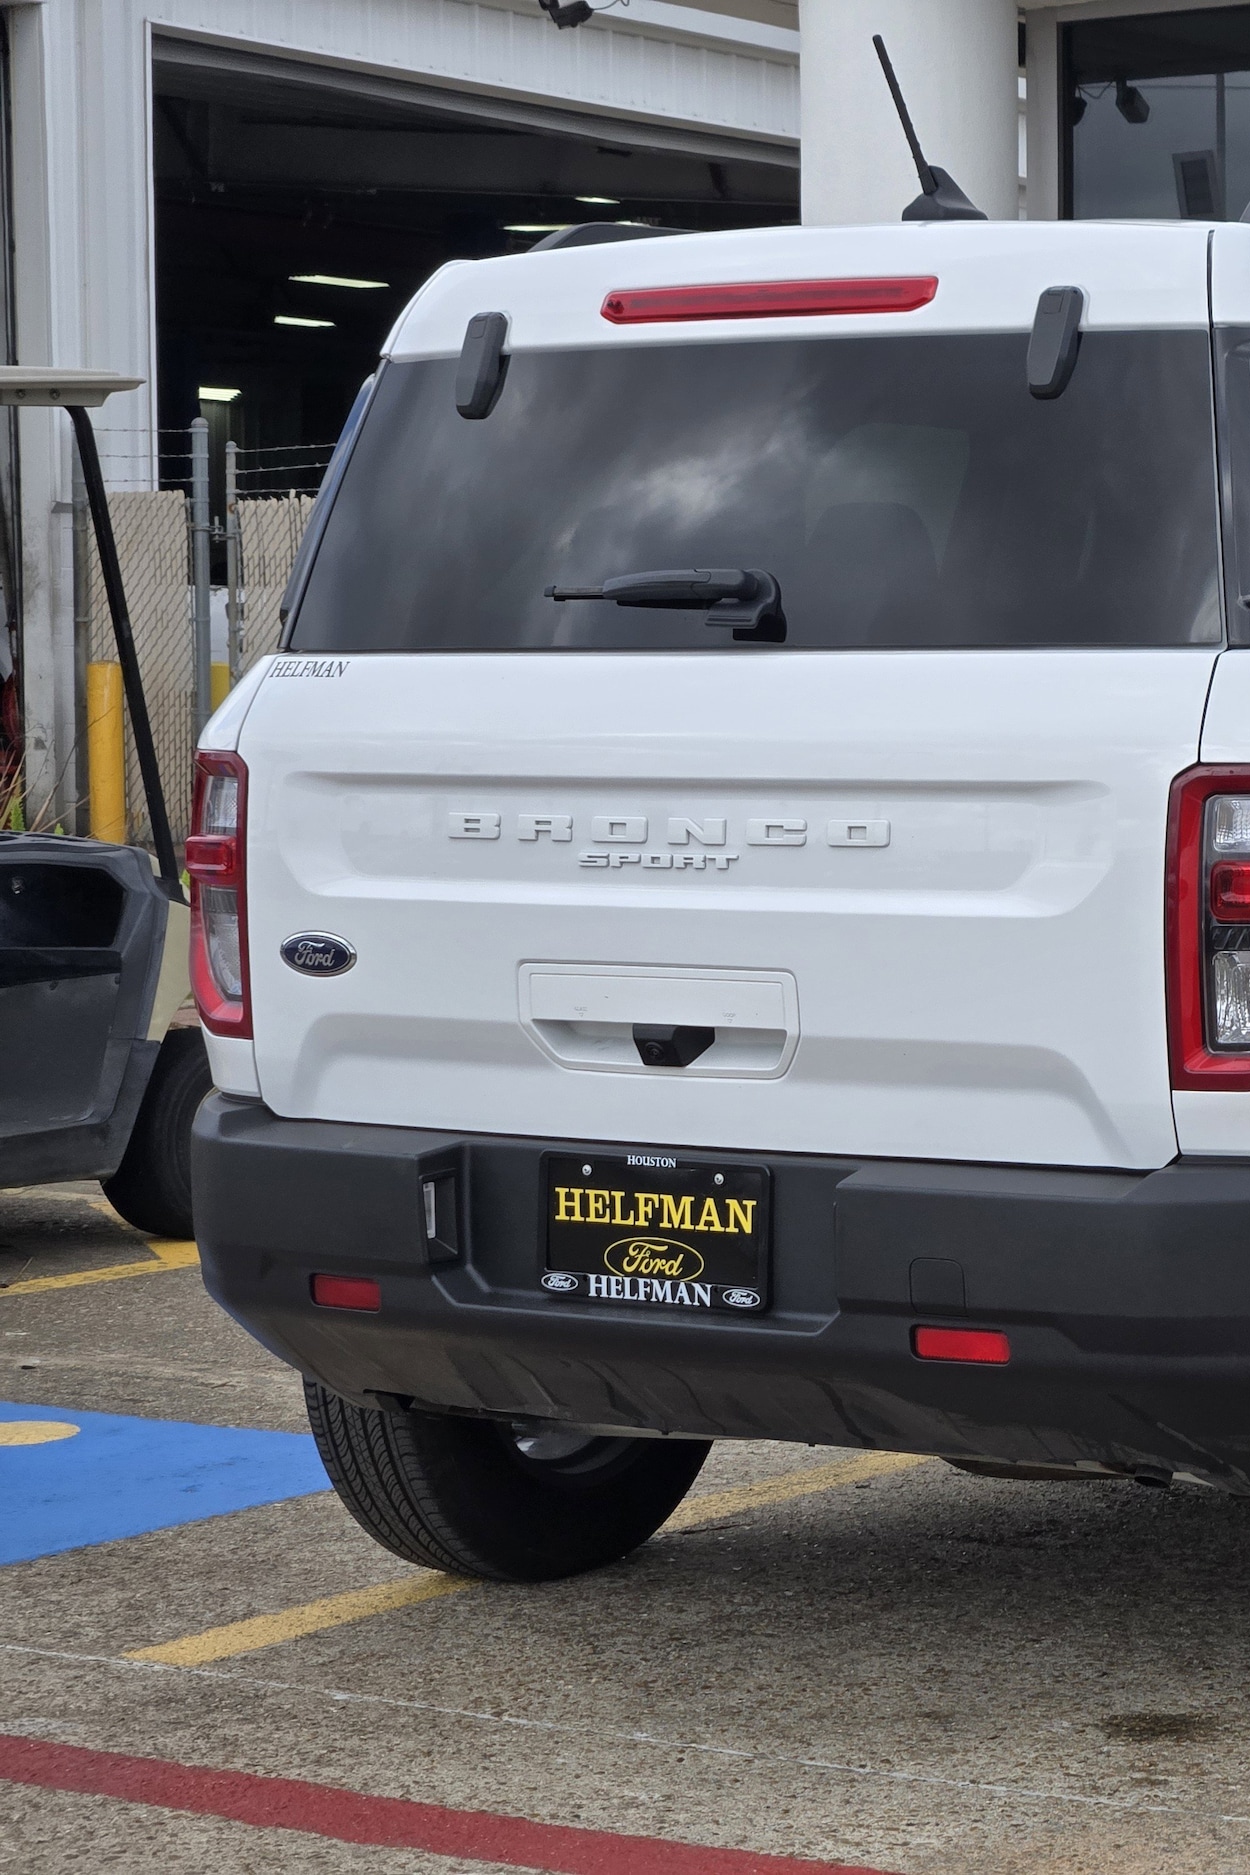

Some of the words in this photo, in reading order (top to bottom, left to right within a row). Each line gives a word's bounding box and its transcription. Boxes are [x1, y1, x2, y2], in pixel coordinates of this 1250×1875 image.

[269, 660, 351, 679] HELFMAN
[448, 811, 891, 849] BRONCO
[577, 851, 740, 870] SPORT
[294, 940, 336, 967] Ford
[626, 1154, 677, 1169] HOUSTON
[554, 1186, 757, 1234] HELFMAN
[622, 1241, 685, 1277] Ford
[547, 1275, 572, 1289] Ford
[587, 1274, 713, 1308] HELFMAN
[728, 1291, 754, 1305] Ford
